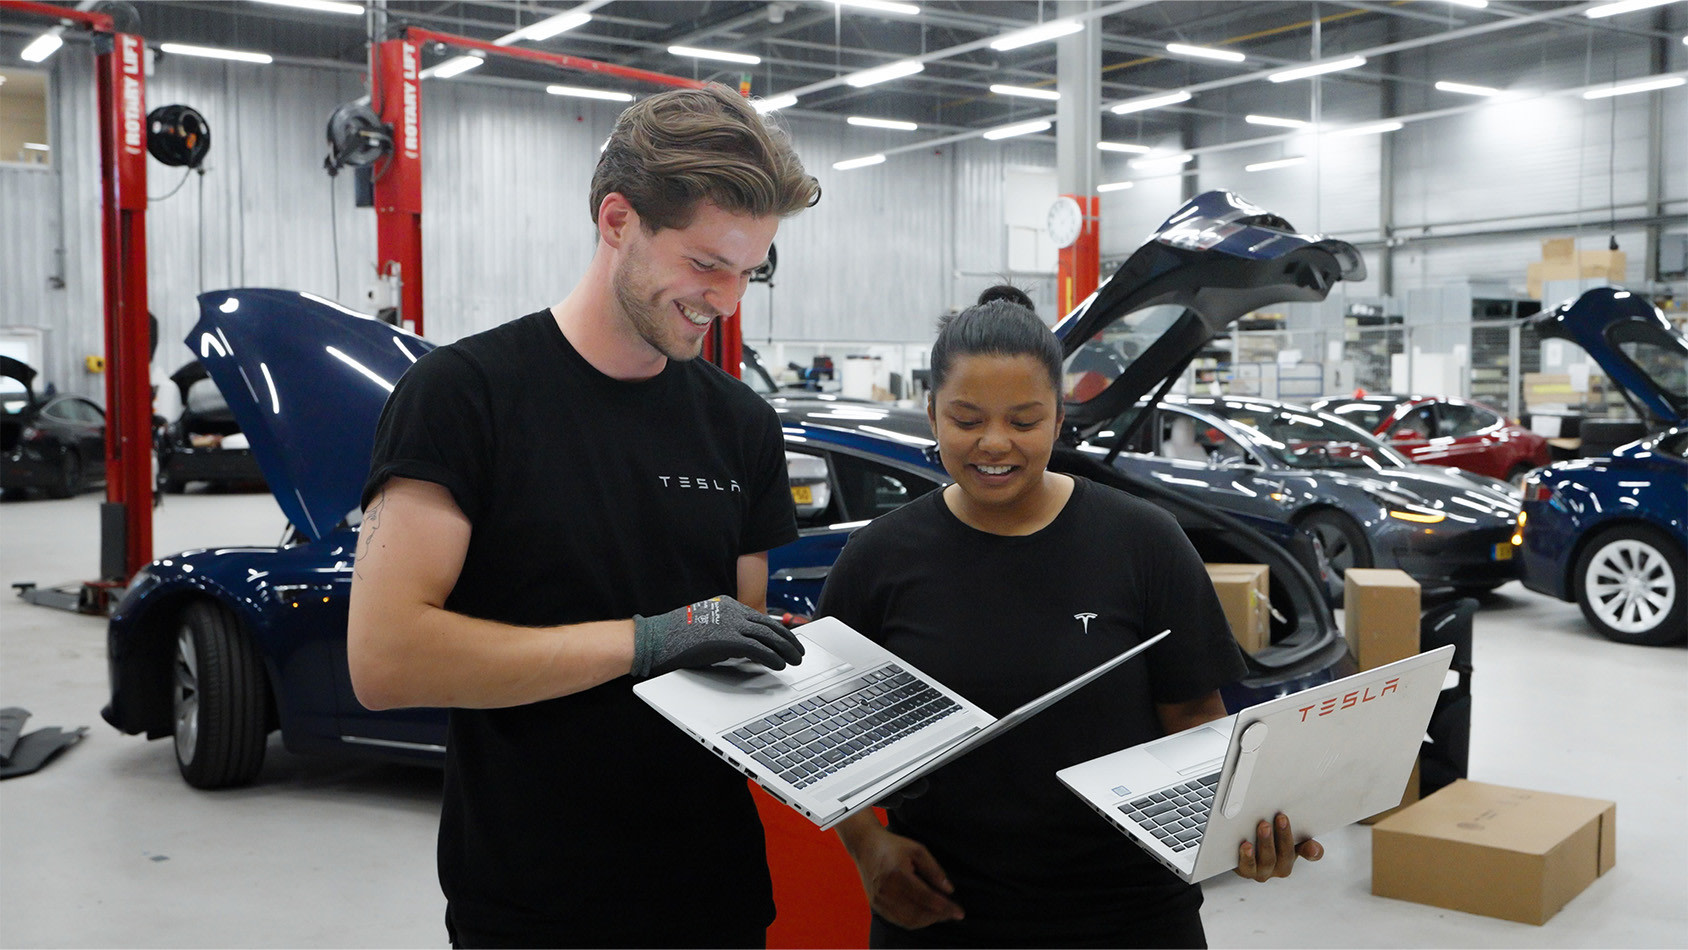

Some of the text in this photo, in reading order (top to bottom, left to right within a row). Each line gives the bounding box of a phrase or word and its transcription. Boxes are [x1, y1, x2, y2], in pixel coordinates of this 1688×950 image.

[122, 35, 141, 146] ROTARY LIFT
[403, 41, 418, 151] ROTARY LIFT
[658, 475, 741, 493] TESLA
[1298, 677, 1400, 722] TESLA
